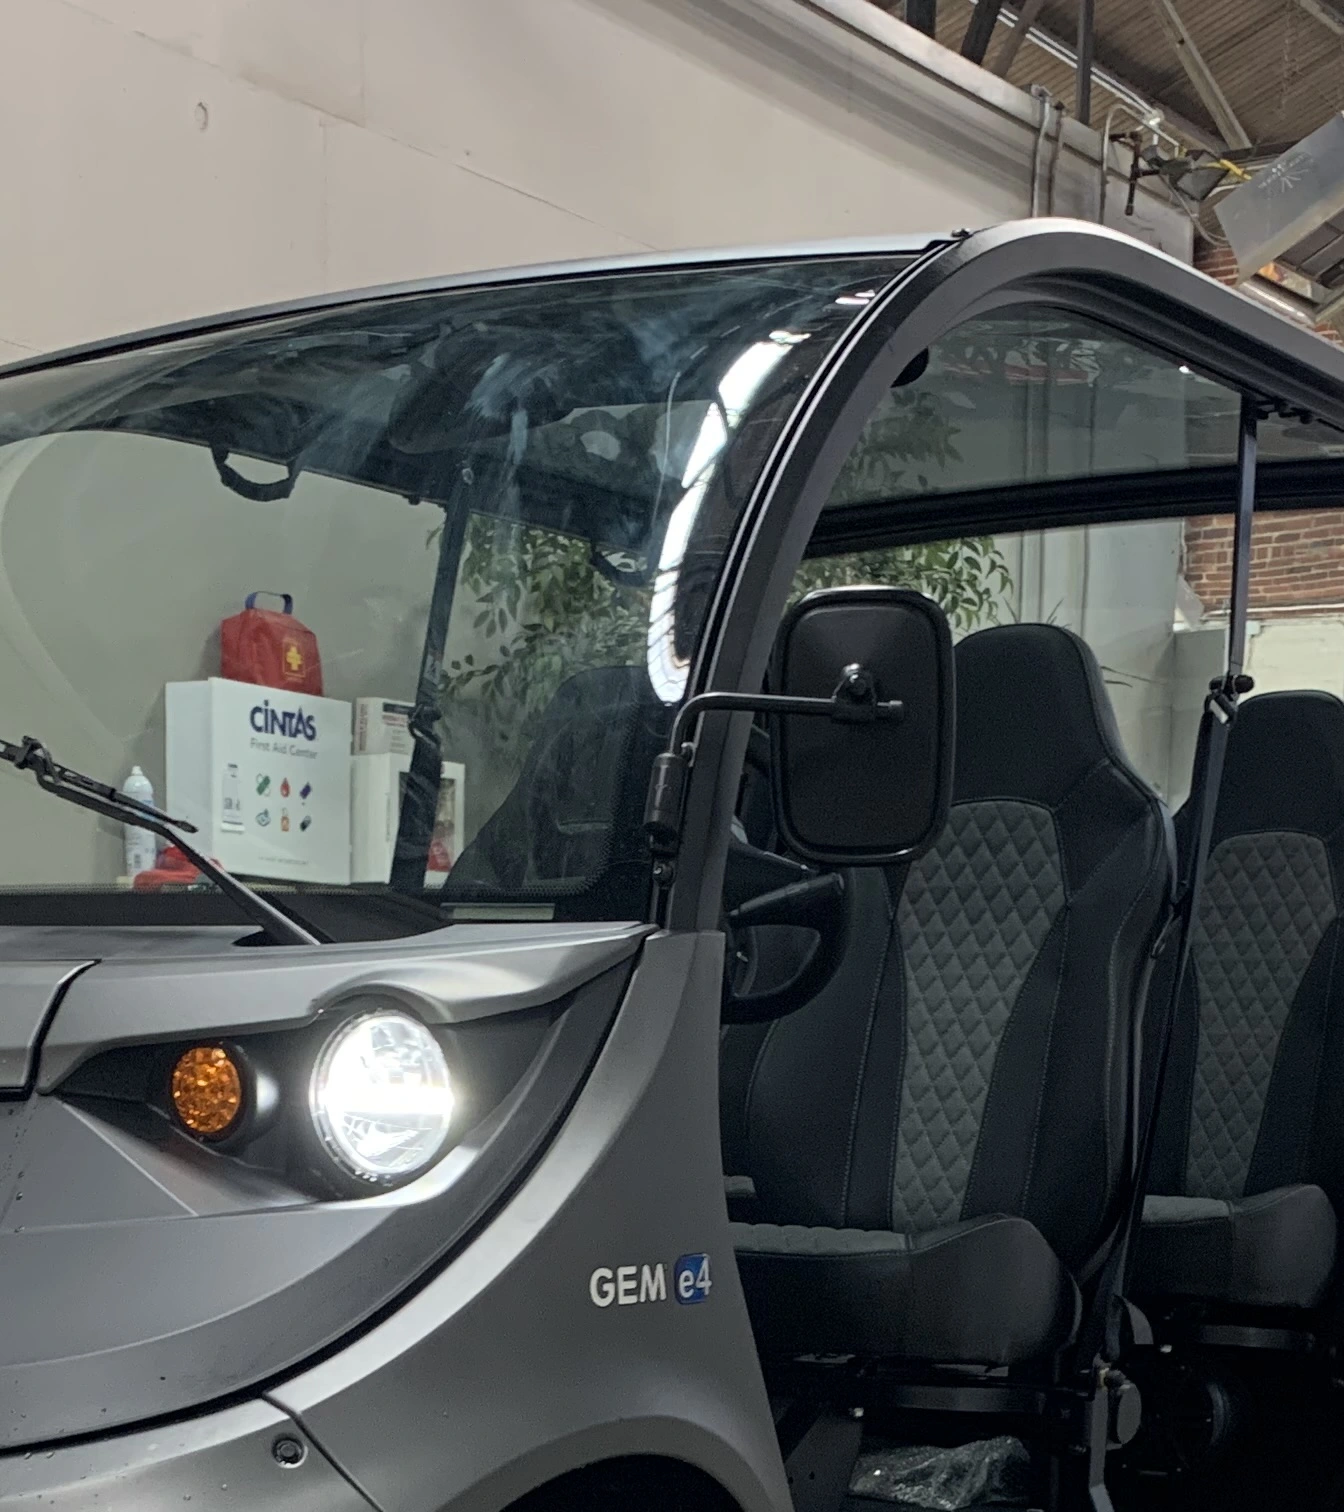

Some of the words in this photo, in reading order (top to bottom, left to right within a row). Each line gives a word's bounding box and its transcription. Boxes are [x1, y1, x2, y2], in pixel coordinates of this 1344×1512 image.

[250, 737, 270, 752] First
[273, 742, 287, 754] Aid
[290, 744, 318, 759] Center
[589, 1263, 667, 1308] GEM
[678, 1253, 712, 1299] e4
